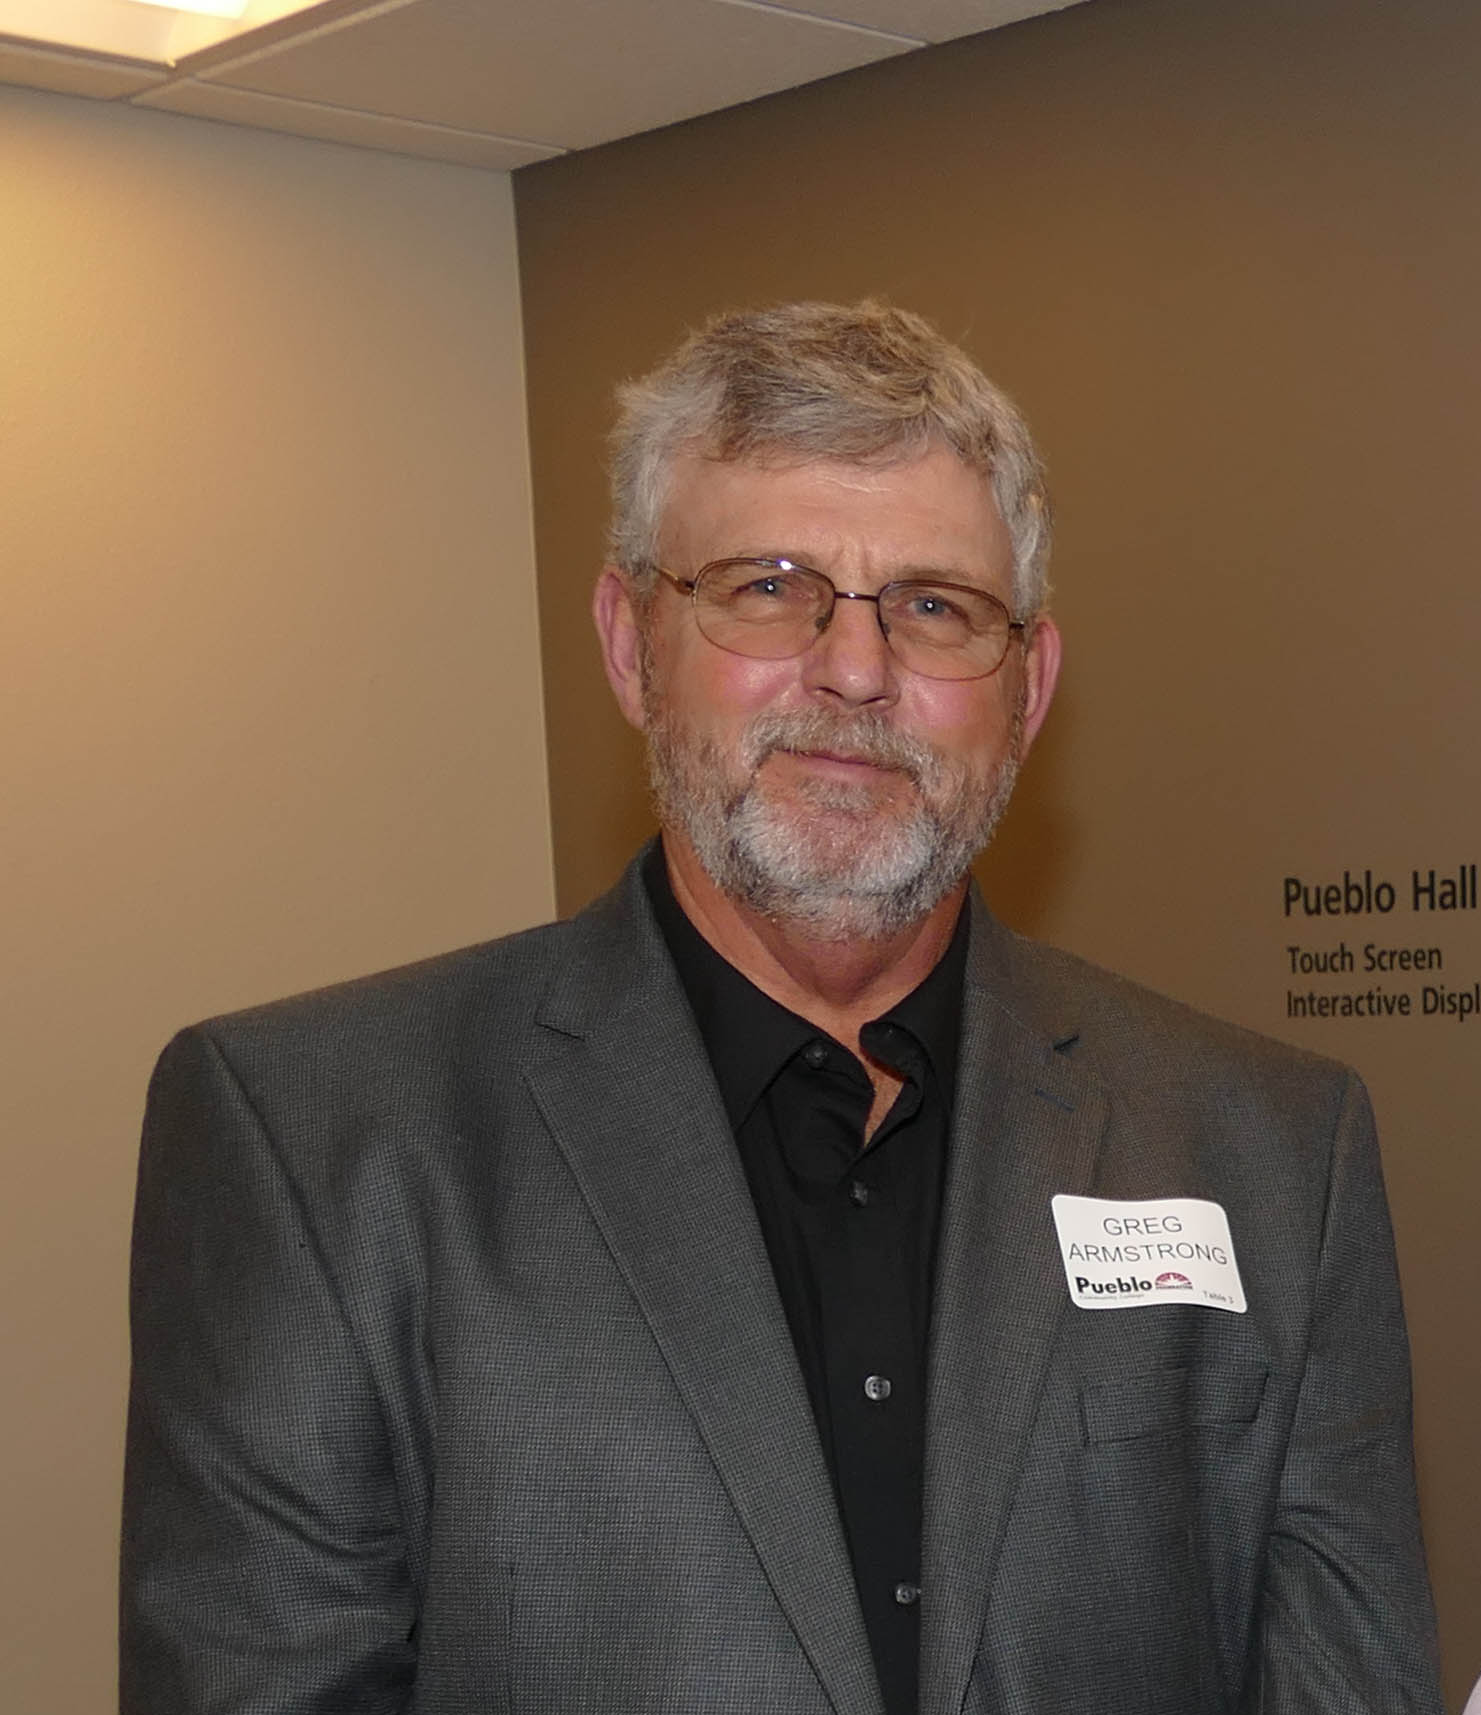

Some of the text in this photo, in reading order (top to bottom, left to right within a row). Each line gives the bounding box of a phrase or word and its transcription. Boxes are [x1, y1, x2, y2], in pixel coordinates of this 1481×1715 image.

[1283, 869, 1397, 916] Pueblo
[1412, 864, 1478, 911] Hall
[1287, 942, 1443, 974] Touch Screen
[1286, 986, 1411, 1018] Interactive
[1103, 1216, 1182, 1236] GREG
[1069, 1242, 1228, 1265] ARMSTRONG
[1075, 1276, 1153, 1294] Pueblo
